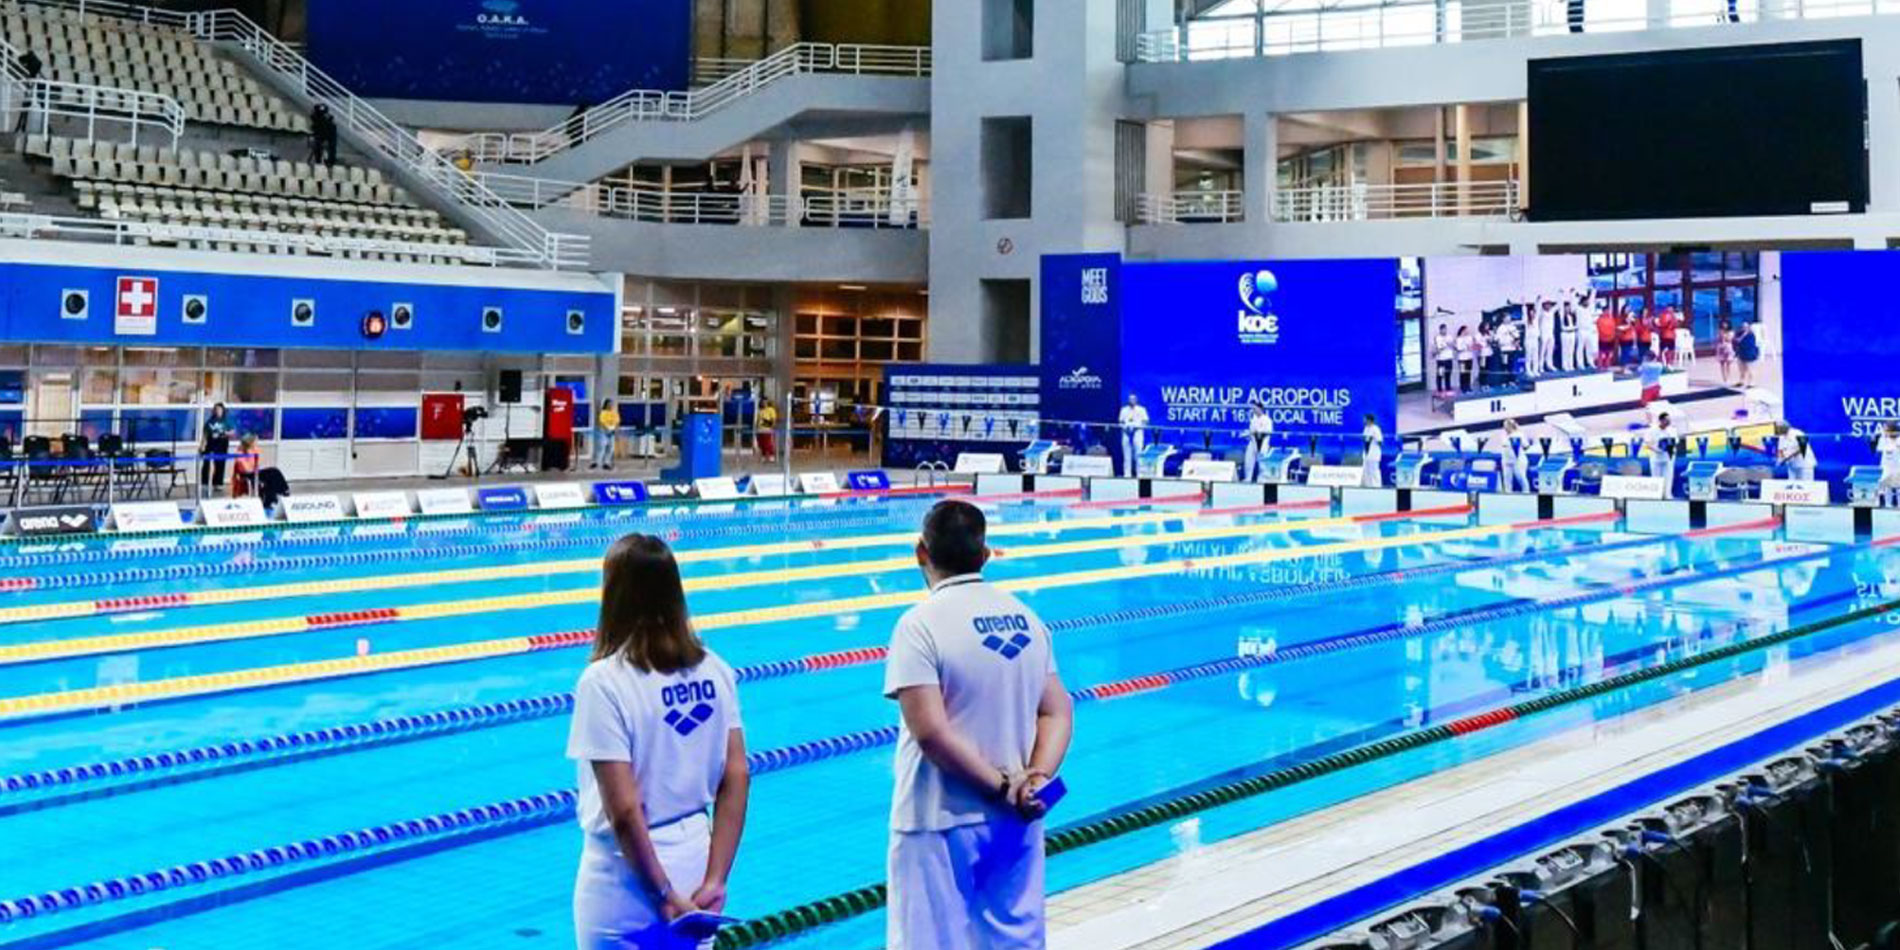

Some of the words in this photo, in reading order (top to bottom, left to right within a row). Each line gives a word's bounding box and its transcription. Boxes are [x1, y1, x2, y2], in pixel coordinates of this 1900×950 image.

[1082, 268, 1107, 286] MEET
[1162, 387, 1214, 404] WARM
[1220, 388, 1243, 405] UP
[1248, 388, 1351, 407] ACROPOLIS
[1168, 407, 1208, 421] START
[1211, 408, 1227, 422] AT
[1313, 411, 1343, 425] TIME
[1842, 397, 1900, 417] WAR
[1852, 421, 1900, 438] STA
[973, 614, 1029, 634] arena
